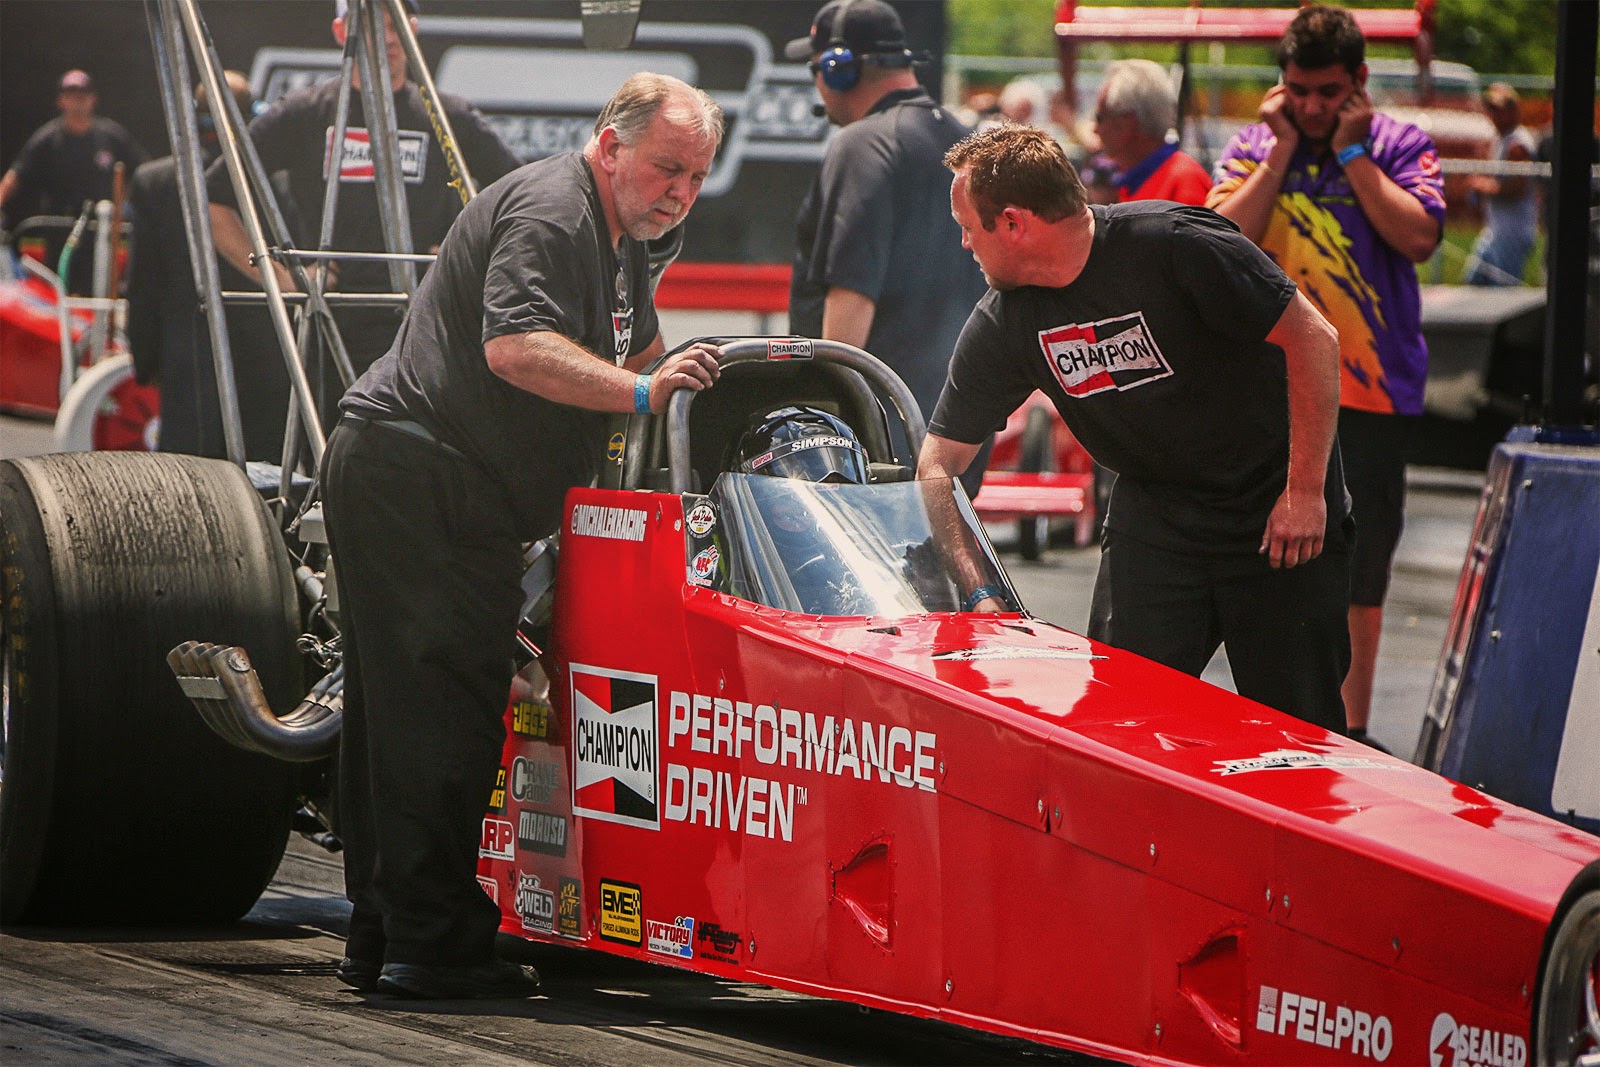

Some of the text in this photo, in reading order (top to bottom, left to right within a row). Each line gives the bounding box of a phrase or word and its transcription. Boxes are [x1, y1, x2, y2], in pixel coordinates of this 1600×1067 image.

[771, 344, 811, 353] CHAMPION
[1056, 337, 1151, 376] CHAMPION
[791, 436, 853, 451] SIMPSON
[753, 453, 772, 467] SIMPSON
[513, 702, 548, 737] JEGS
[577, 717, 652, 773] CHAMPION
[668, 690, 937, 793] PERFORMANCE
[664, 762, 794, 843] DRIVEN
[482, 821, 513, 852] RP
[519, 811, 566, 845] MOROSO
[524, 890, 553, 919] WELD
[603, 889, 634, 916] BME
[524, 916, 553, 929] RACING
[647, 921, 690, 945] VICTORY
[1278, 991, 1393, 1062] FEL-PRO
[1459, 1024, 1527, 1067] SEALED
